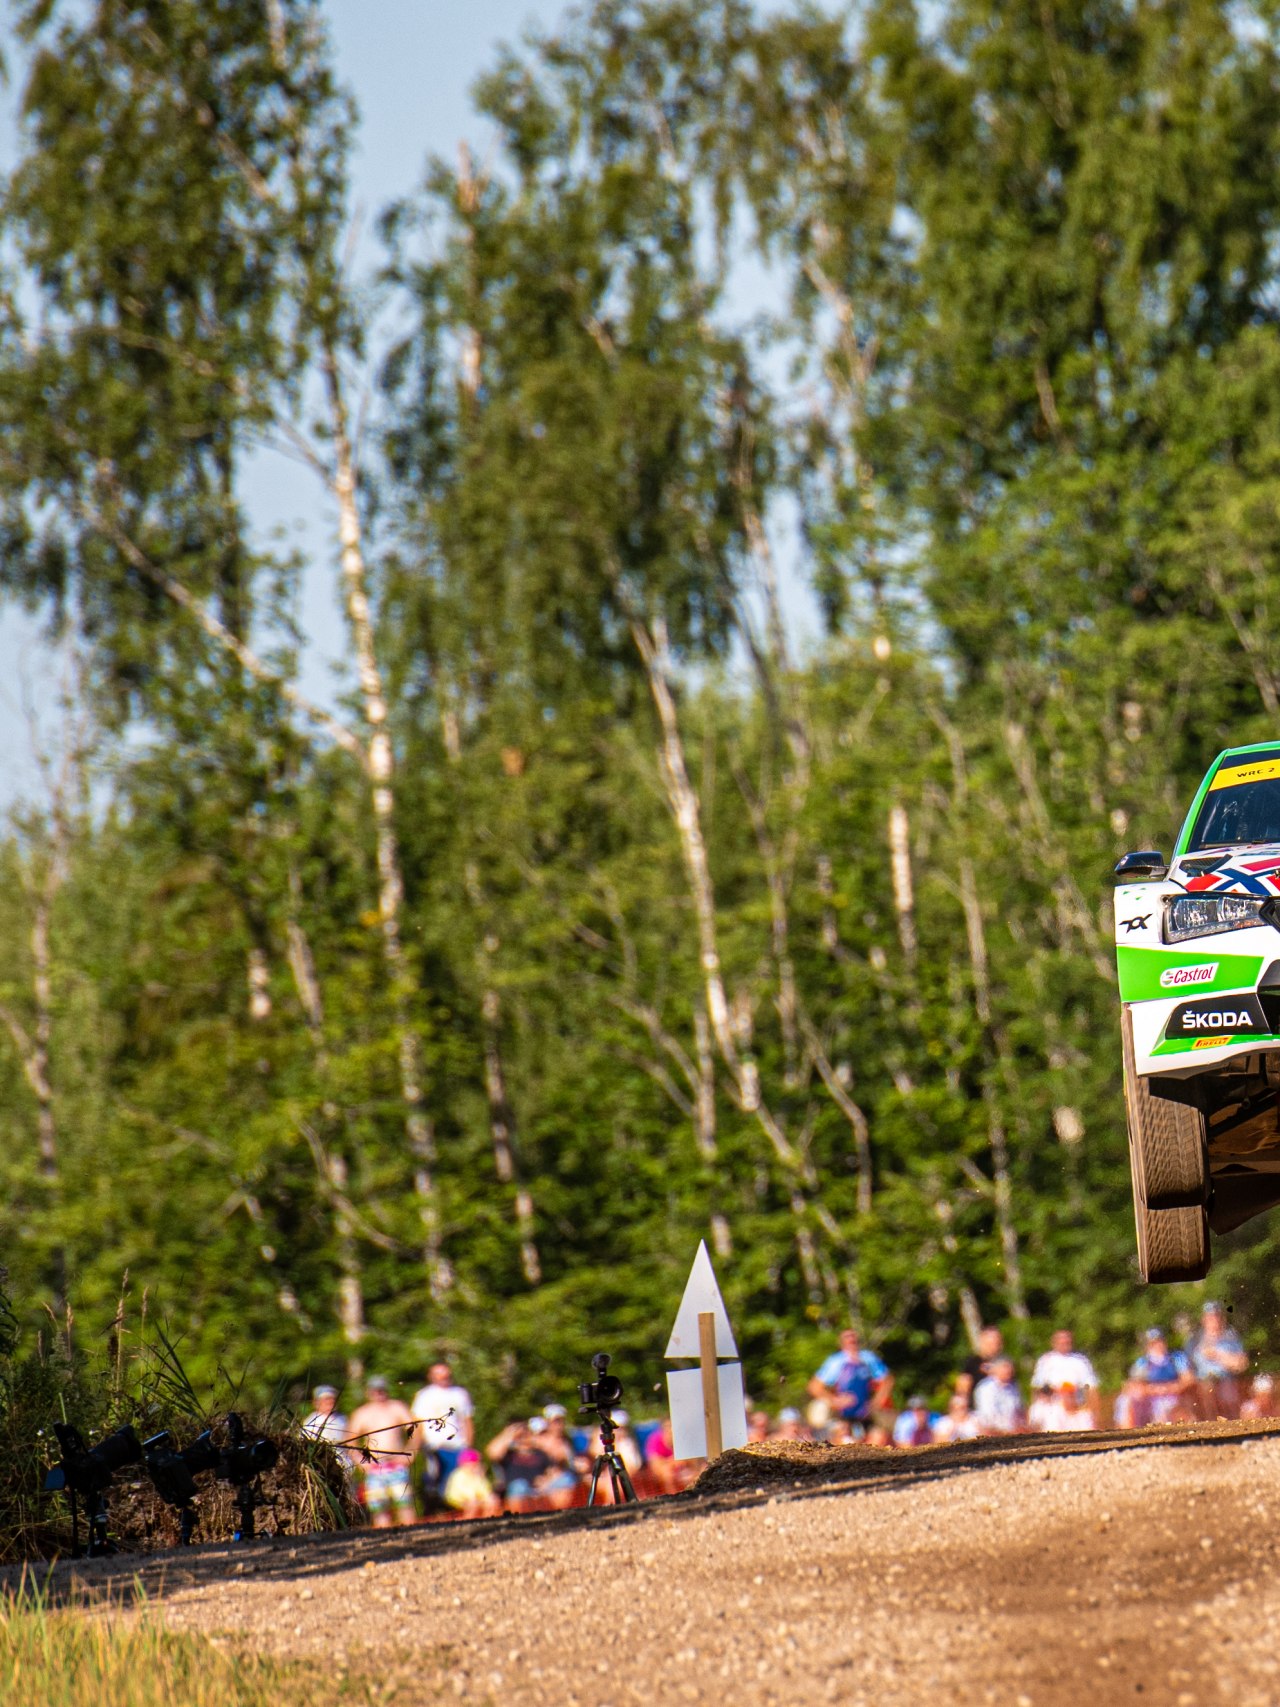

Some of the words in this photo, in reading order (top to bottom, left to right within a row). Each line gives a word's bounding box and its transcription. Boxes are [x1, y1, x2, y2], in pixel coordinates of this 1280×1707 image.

[1236, 769, 1264, 779] WRC
[1173, 965, 1214, 984] Castrol
[1182, 1010, 1253, 1029] ŠKODA
